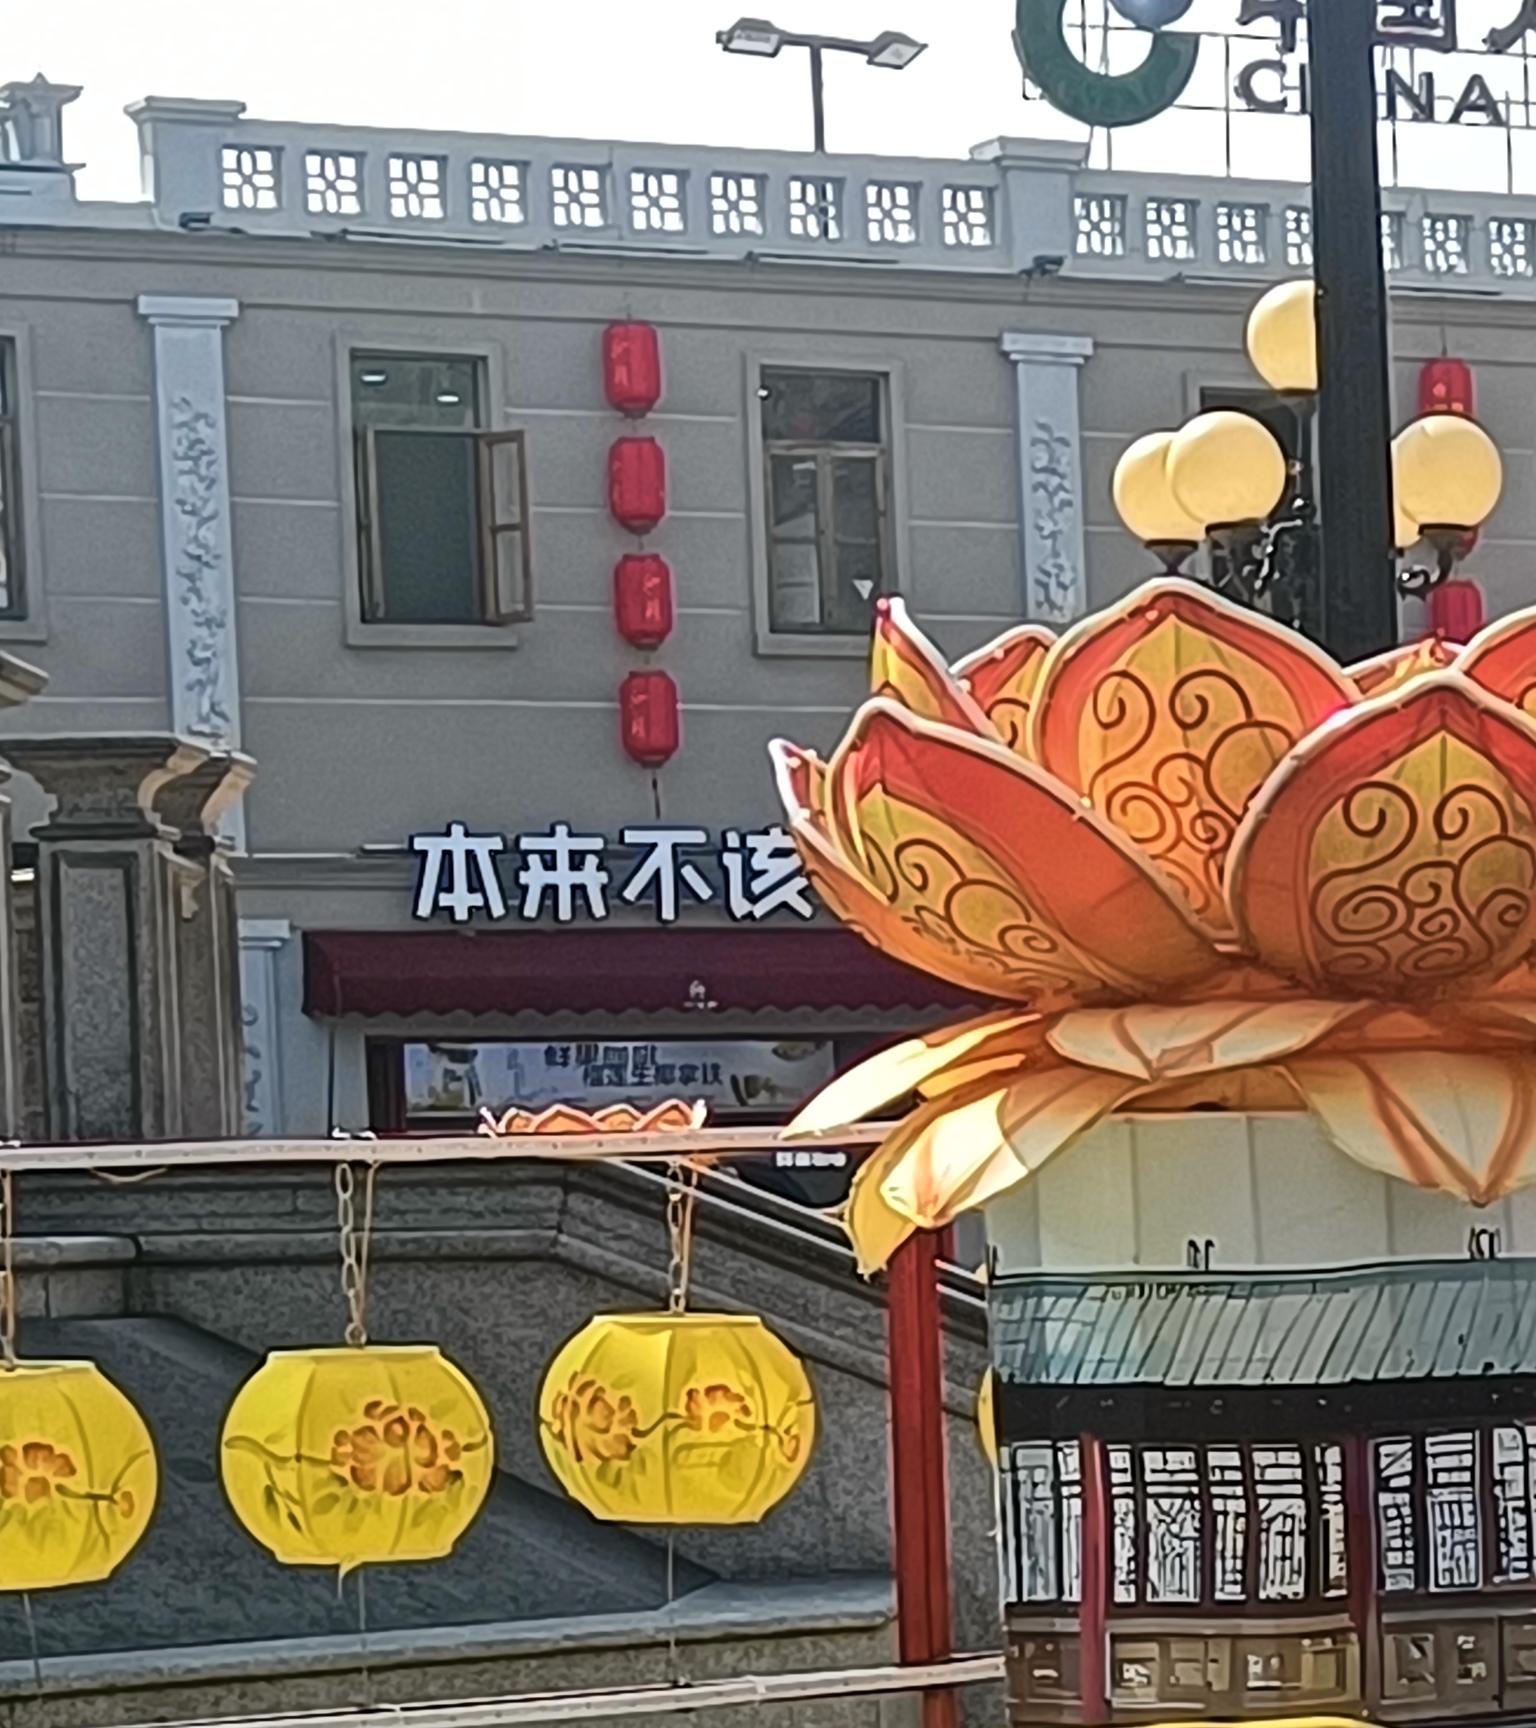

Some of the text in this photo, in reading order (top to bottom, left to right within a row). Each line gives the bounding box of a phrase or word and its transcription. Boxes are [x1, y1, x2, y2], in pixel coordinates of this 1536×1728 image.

[1234, 58, 1504, 126] CNA
[411, 821, 815, 922] 本来不该
